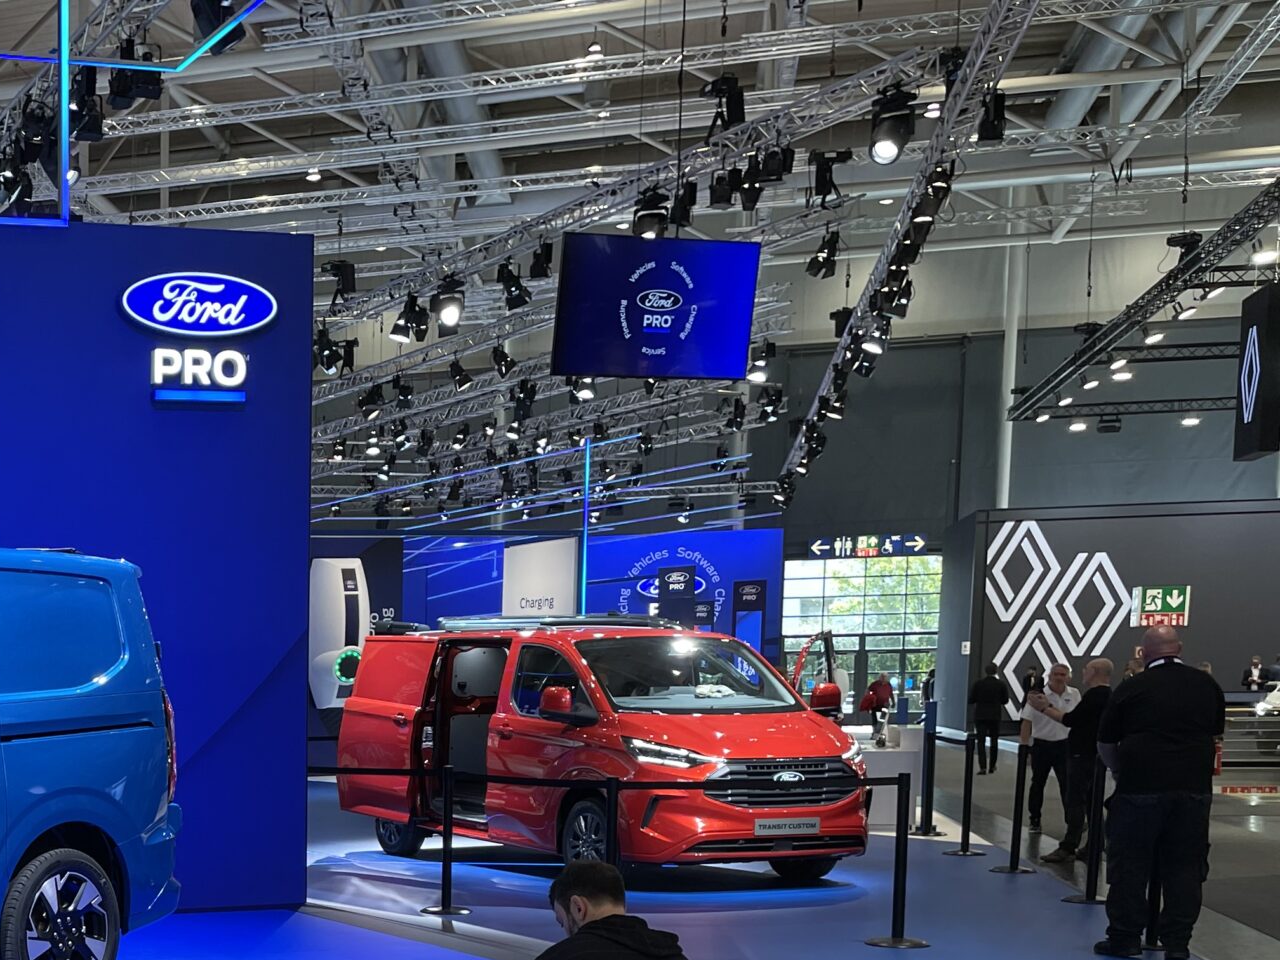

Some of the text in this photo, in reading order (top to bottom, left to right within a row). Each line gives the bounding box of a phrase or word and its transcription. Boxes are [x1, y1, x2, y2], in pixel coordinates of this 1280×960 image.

[628, 261, 656, 283] Vehicles
[670, 261, 694, 289] Software
[152, 279, 248, 326] Ford
[645, 292, 675, 308] Ford
[619, 299, 632, 340] Financing
[679, 304, 698, 340] Charging
[641, 346, 666, 356] Service
[151, 348, 248, 387] PRO
[676, 546, 720, 583] Software
[520, 597, 554, 610] Charging
[788, 822, 817, 830] CUSTOM
